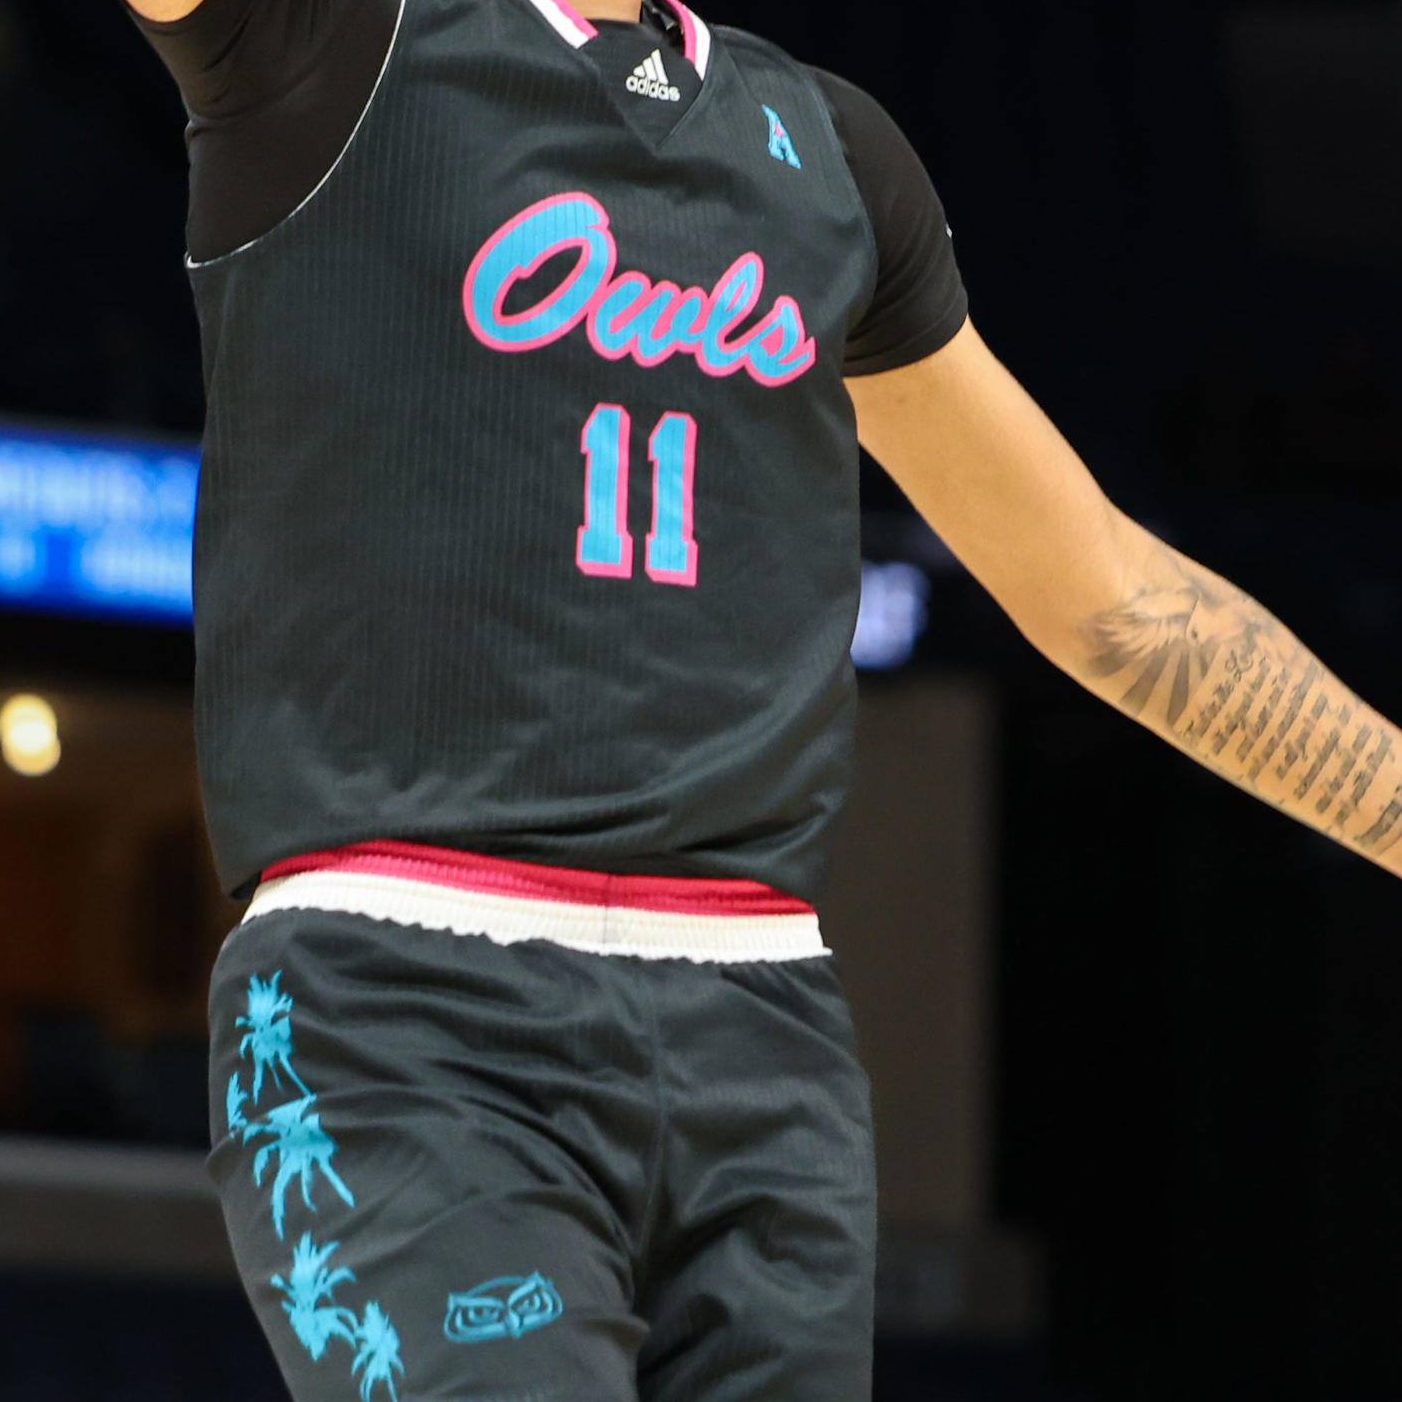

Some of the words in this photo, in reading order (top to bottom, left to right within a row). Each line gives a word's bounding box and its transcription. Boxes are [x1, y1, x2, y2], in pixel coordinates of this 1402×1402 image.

[625, 73, 680, 102] adidas
[462, 191, 816, 388] Owls
[575, 402, 698, 587] 11
